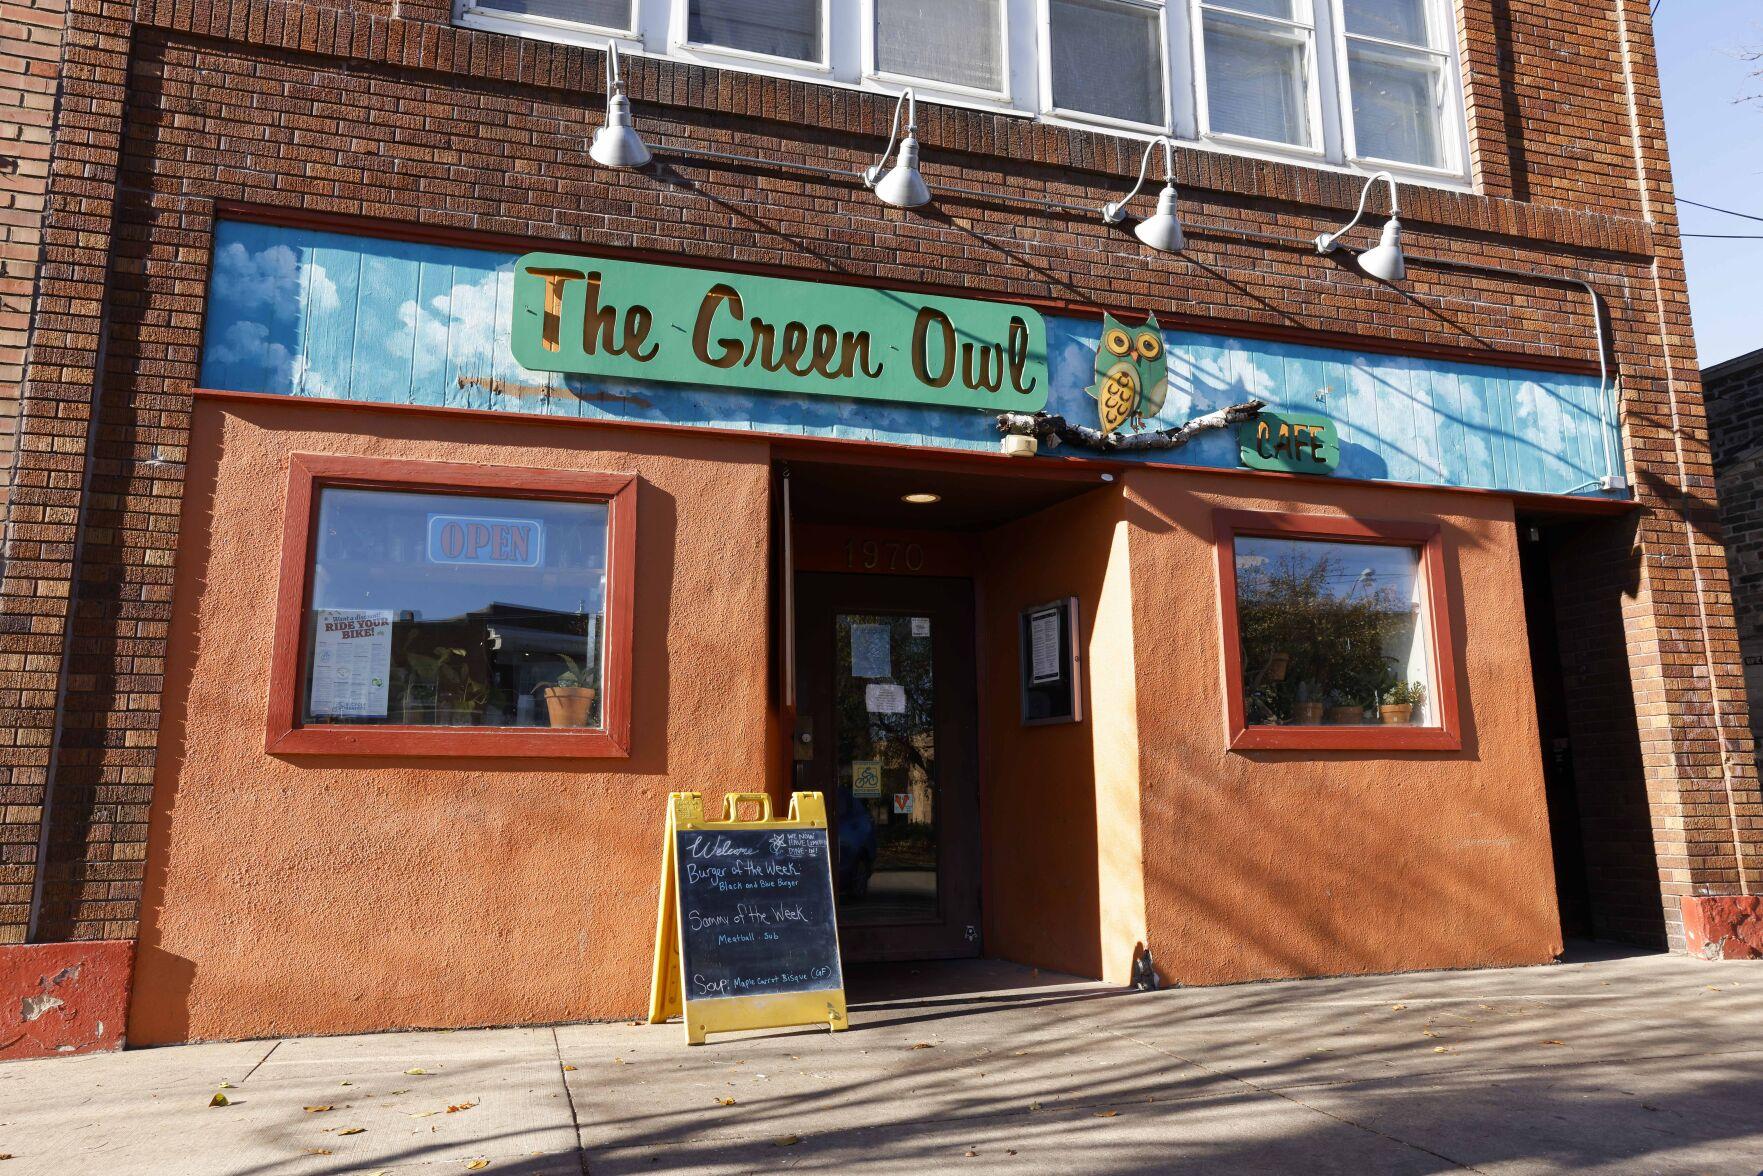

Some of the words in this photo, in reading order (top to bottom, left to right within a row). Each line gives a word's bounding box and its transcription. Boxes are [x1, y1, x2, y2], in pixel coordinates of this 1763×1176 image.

[525, 267, 660, 363] The
[691, 283, 883, 379] Green
[911, 306, 1036, 394] Owl
[1256, 420, 1327, 463] CAFE
[440, 521, 531, 561] OPEN
[842, 536, 924, 571] 1970
[325, 621, 355, 632] RIDE
[357, 618, 389, 628] YOUR
[341, 627, 375, 640] BIKE!
[686, 835, 759, 858] Welcome
[687, 863, 726, 886] Burger
[731, 859, 744, 876] of
[744, 860, 764, 876] the
[719, 880, 743, 891] Black
[745, 880, 758, 889] and
[760, 879, 775, 888] Blue
[778, 878, 799, 889] Burger
[733, 903, 748, 925] of
[748, 903, 771, 925] the
[718, 934, 755, 946] Meatball
[764, 932, 779, 940] Sub
[733, 979, 756, 990] Maple
[757, 977, 780, 986] Carrot
[782, 973, 807, 984] Bisque
[810, 965, 832, 980] (GF)
